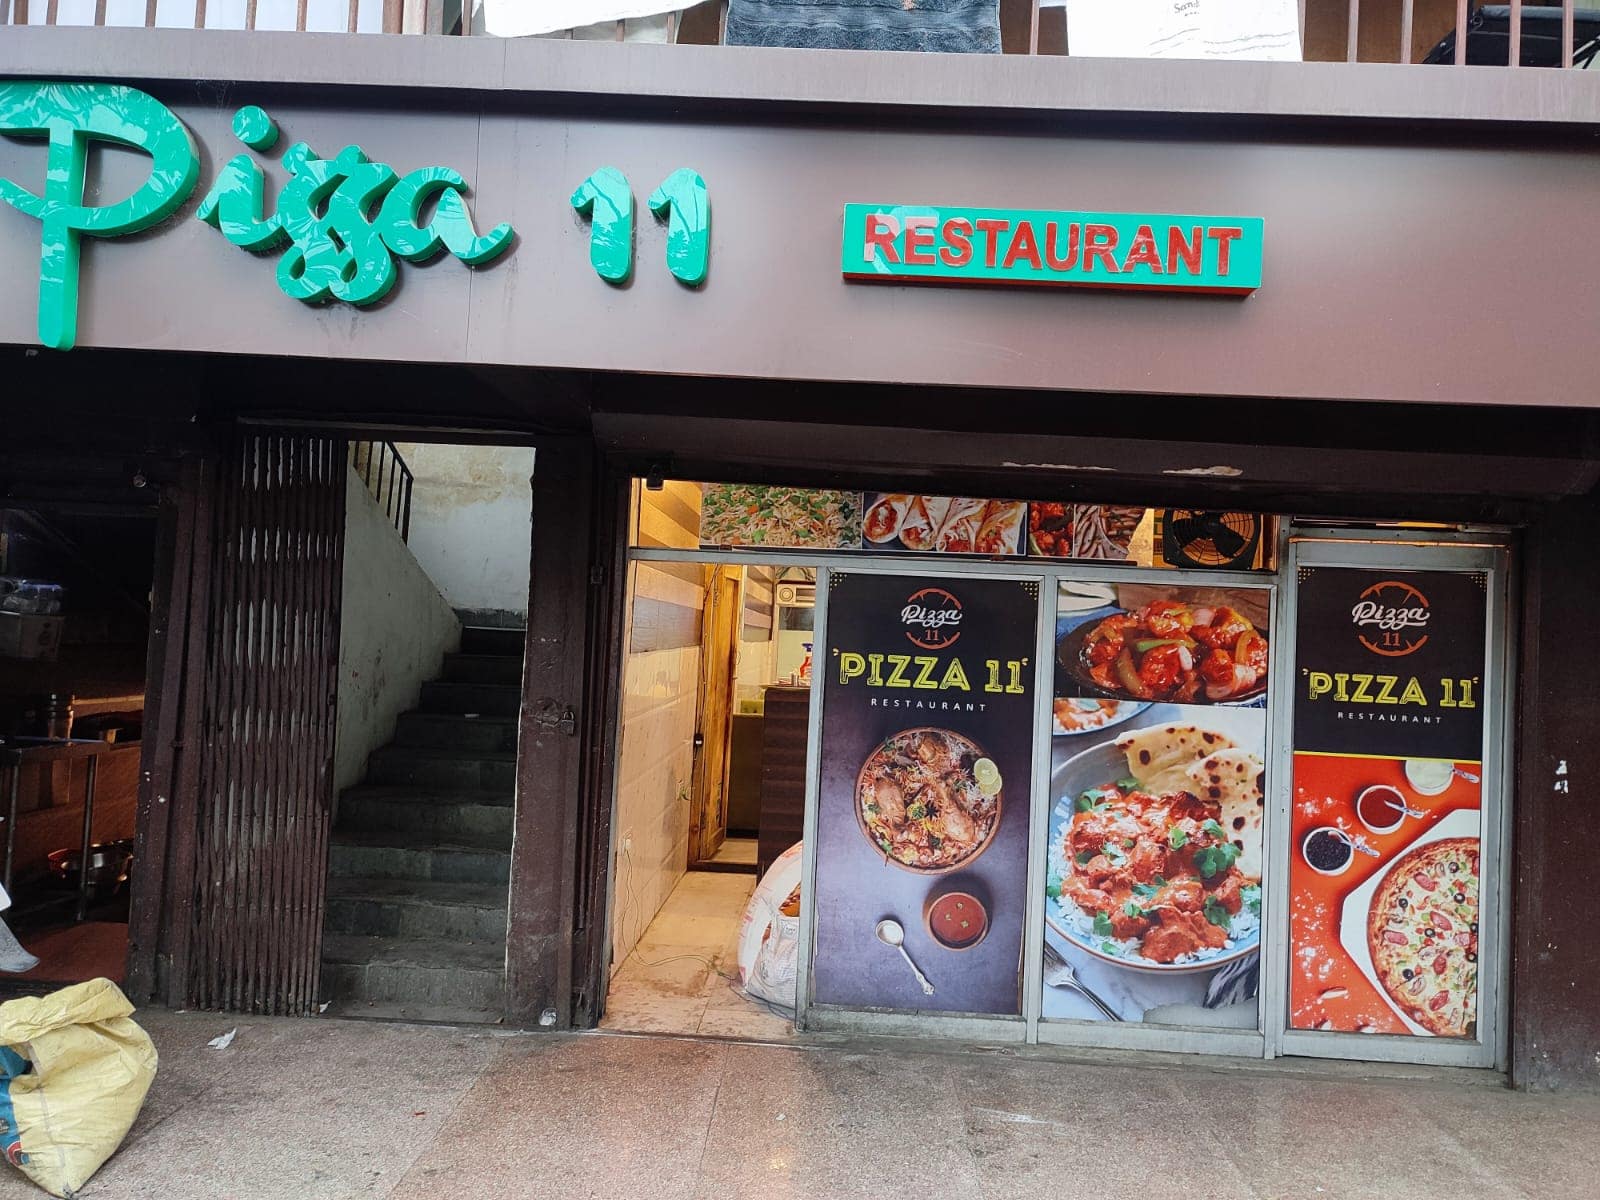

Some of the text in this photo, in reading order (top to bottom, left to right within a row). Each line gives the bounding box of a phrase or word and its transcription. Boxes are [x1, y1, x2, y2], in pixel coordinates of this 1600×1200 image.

[0, 80, 711, 350] Pizza 11
[864, 213, 1243, 276] RESTAURANT
[901, 604, 963, 628] Pizza
[1351, 601, 1431, 630] Pizza
[925, 629, 939, 641] 11
[1383, 632, 1401, 647] 11
[839, 652, 1025, 694] PIZZA 11
[1308, 671, 1476, 708] PIZZA 11
[871, 698, 987, 712] RESTAURANT
[1337, 711, 1442, 724] RESTAURANT
